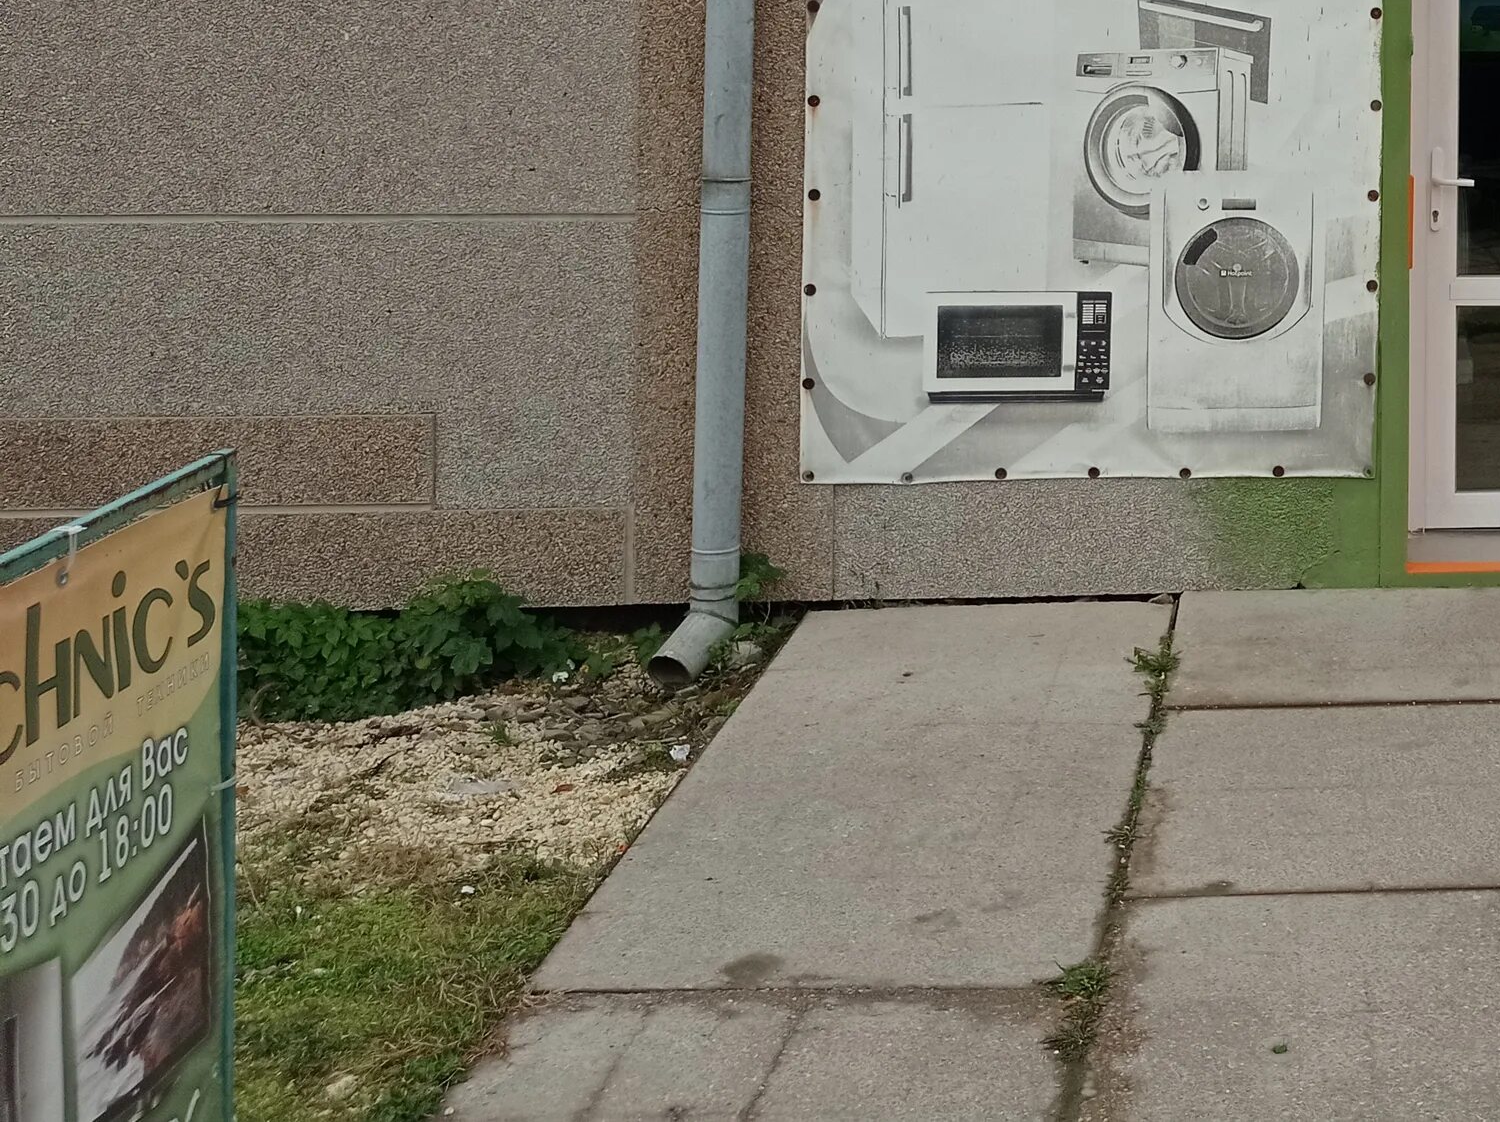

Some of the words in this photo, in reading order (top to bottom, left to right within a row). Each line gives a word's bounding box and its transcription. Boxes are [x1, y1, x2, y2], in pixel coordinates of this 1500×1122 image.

[15, 711, 115, 792] БЫТОВОЙ
[136, 652, 211, 718] ТЕХНИКИ
[142, 726, 189, 791] Вас
[98, 783, 174, 884] 18:00
